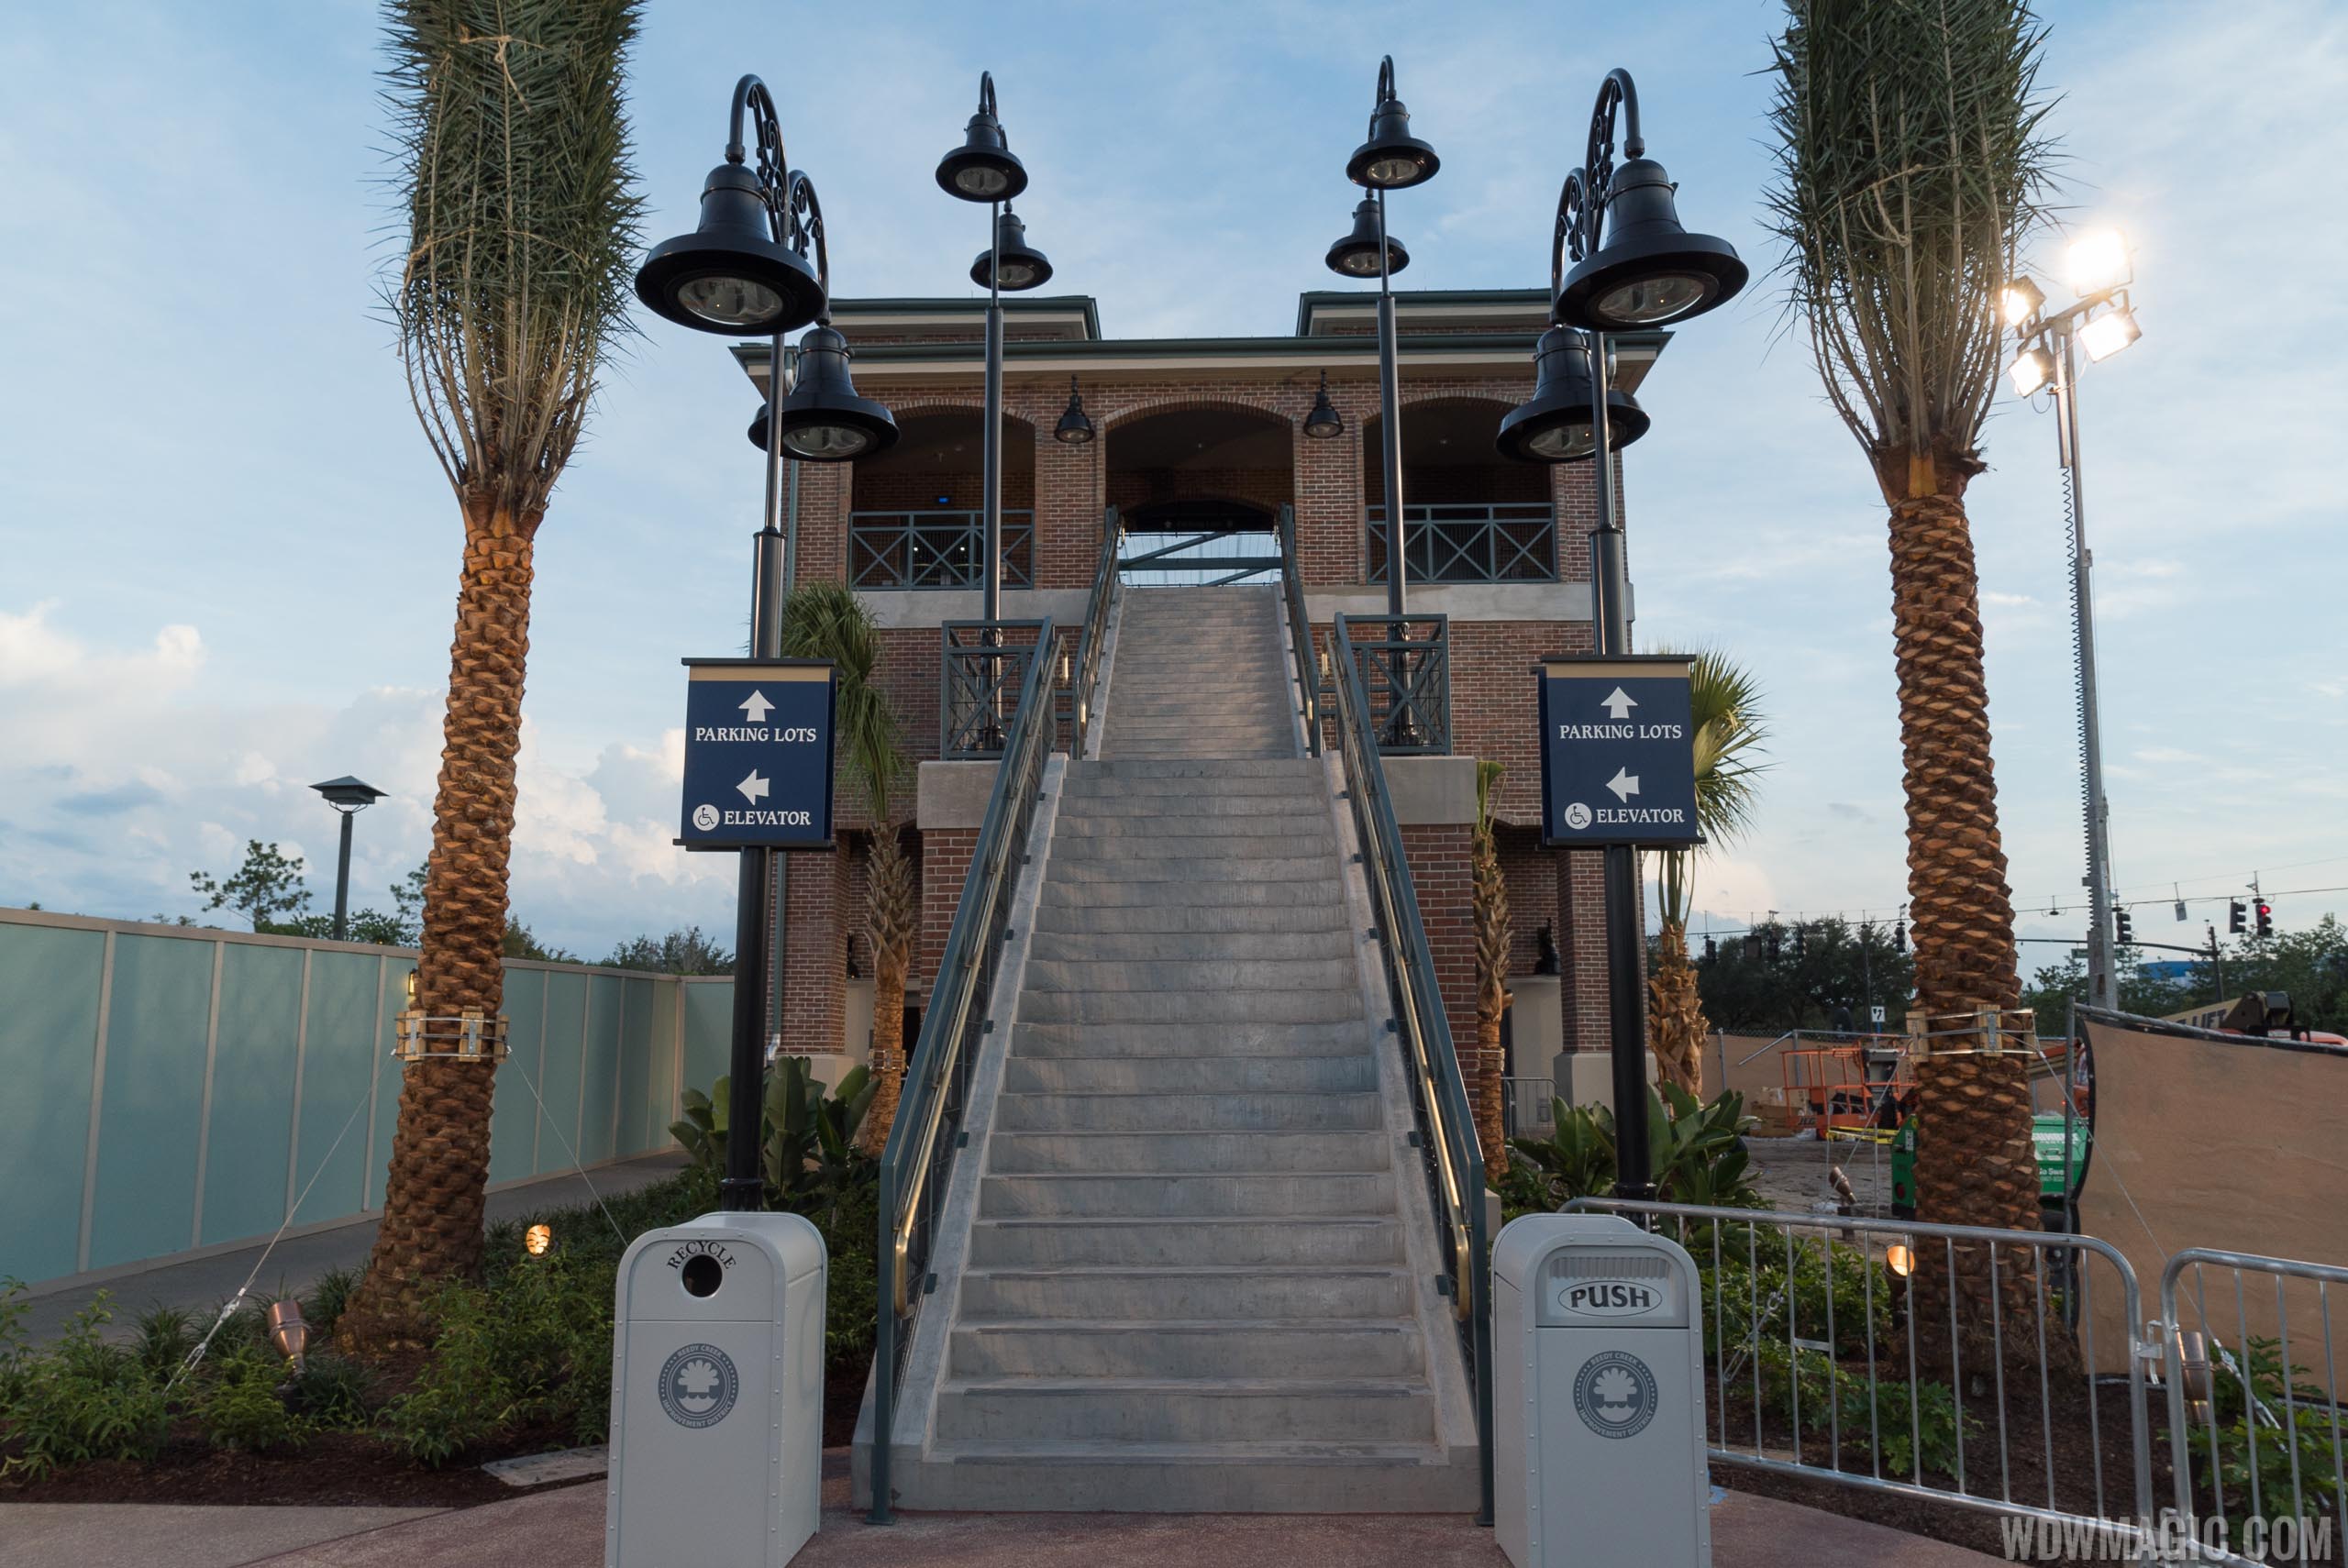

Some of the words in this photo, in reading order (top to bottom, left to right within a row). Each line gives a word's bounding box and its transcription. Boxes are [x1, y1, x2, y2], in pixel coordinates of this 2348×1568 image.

[695, 727, 769, 742] PARKING
[774, 728, 816, 742] LOTS
[1559, 724, 1634, 739] PARKING
[1639, 724, 1682, 739] LOTS
[724, 811, 812, 825] ELEVATOR
[1596, 809, 1685, 823] ELEVATOR
[667, 1240, 737, 1270] RECYCLE
[1570, 1285, 1651, 1309] PUSH
[701, 1345, 723, 1358] CREEK
[1590, 1353, 1613, 1365] REEDY
[1614, 1353, 1639, 1365] CREEK
[662, 1399, 706, 1427] IMPROVEMENT
[707, 1401, 733, 1425] DISTRICT
[1578, 1408, 1628, 1438] IMPROVEMENT
[1627, 1409, 1653, 1434] DISTRICT
